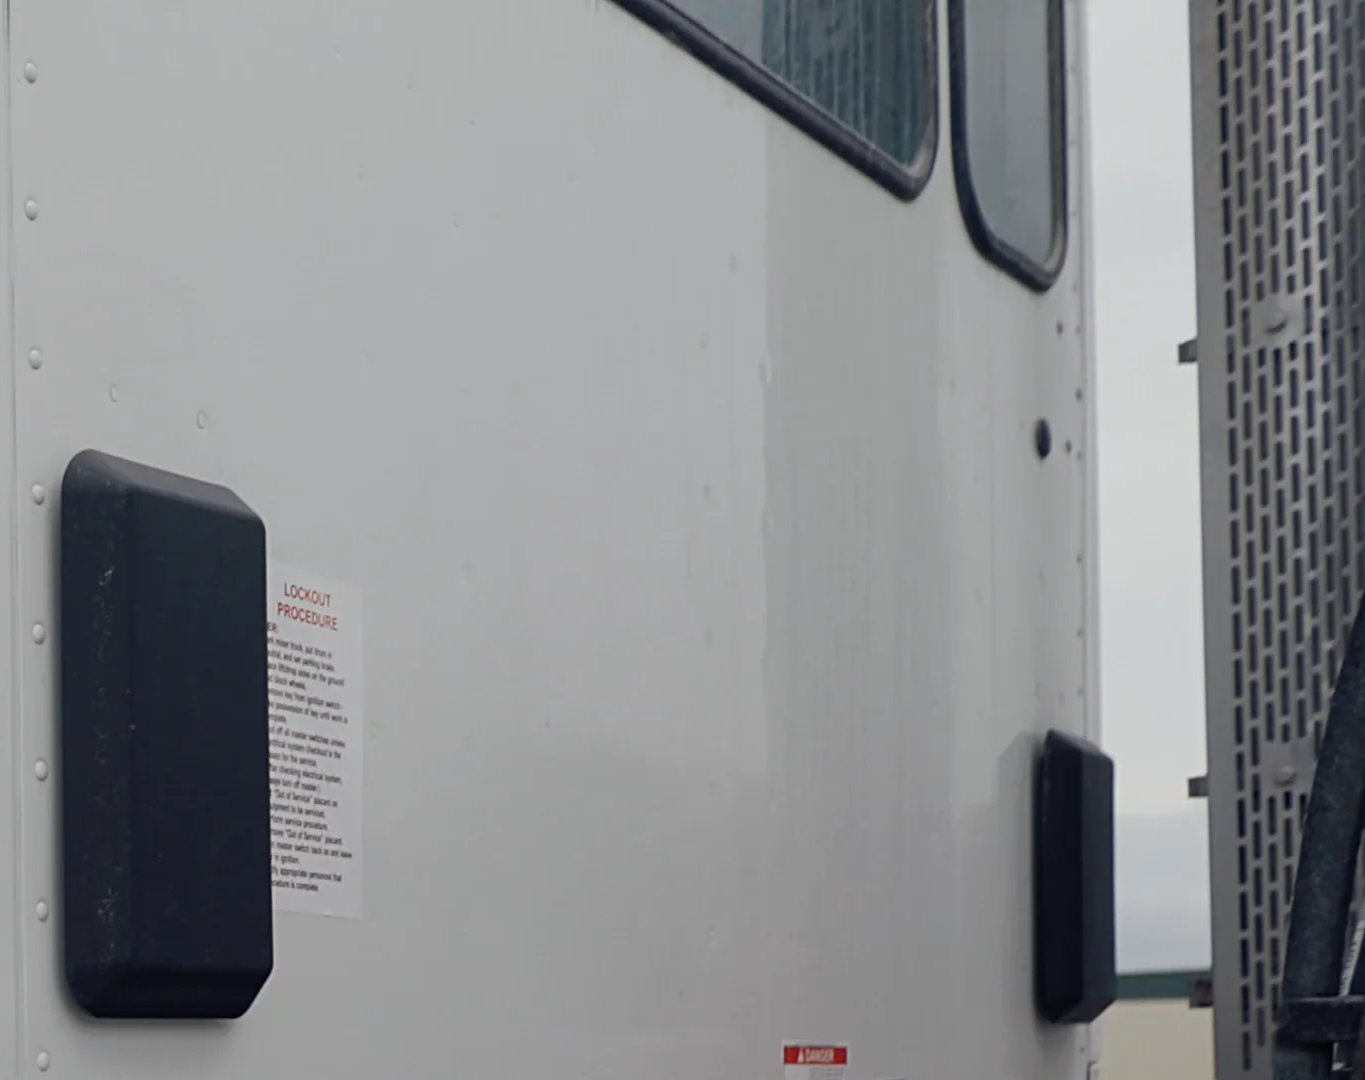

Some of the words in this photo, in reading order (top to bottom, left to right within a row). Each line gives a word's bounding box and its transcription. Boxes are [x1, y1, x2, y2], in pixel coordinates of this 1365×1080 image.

[284, 582, 331, 607] LOCKOUT
[277, 602, 338, 631] PROCEDURE
[805, 1049, 835, 1063] DANGER
